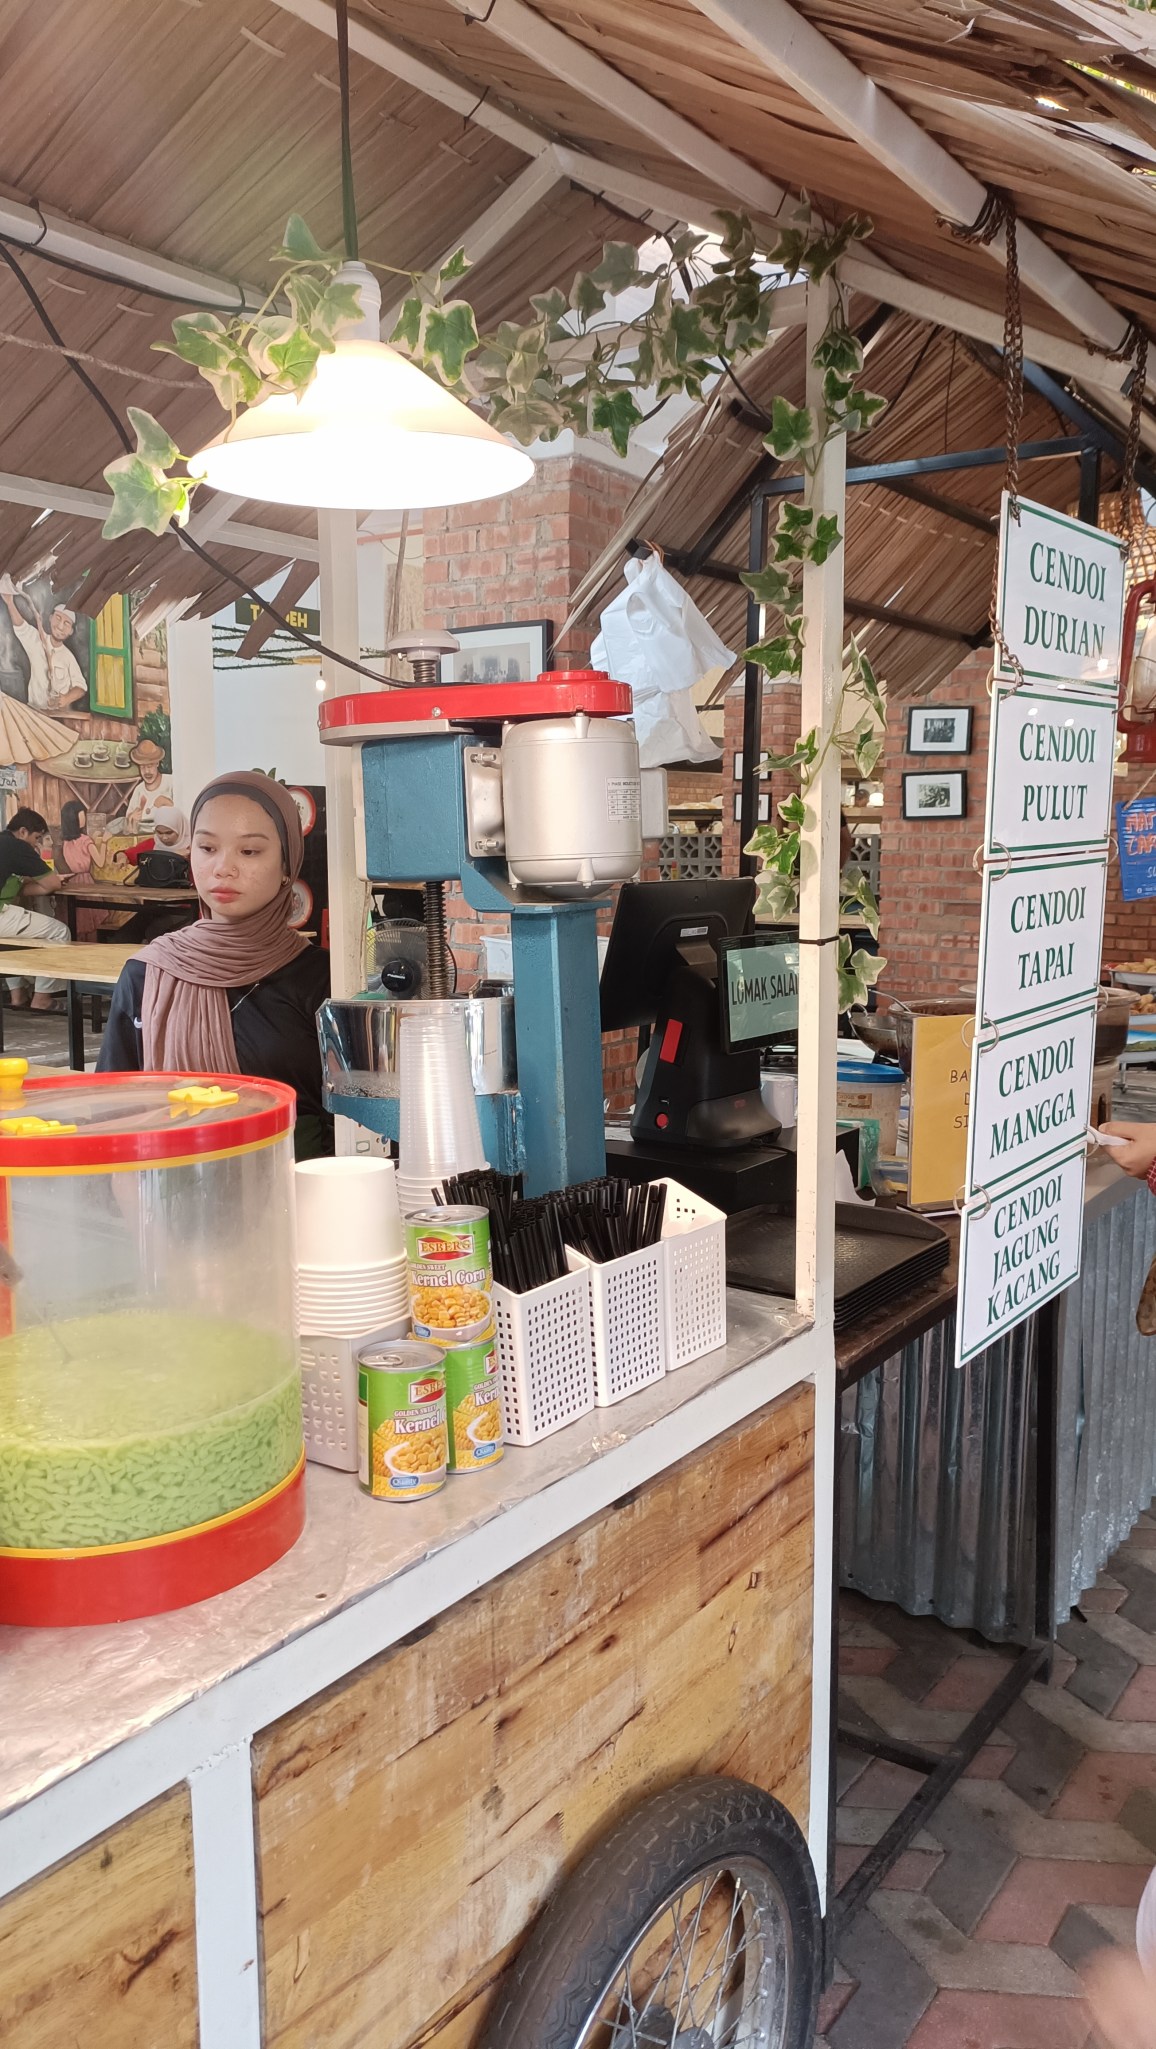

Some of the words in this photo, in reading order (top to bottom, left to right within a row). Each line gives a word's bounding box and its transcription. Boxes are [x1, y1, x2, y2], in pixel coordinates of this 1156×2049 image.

[1030, 542, 1107, 602] CENDOI
[1023, 604, 1106, 659] DURIAN
[1018, 722, 1096, 763] CENDOI
[1021, 783, 1089, 822] PULUT
[1010, 886, 1086, 934] CENDOI
[1018, 942, 1075, 990] TAPAI
[731, 976, 768, 1006] LOMAK
[998, 1036, 1076, 1099] CENDOI
[989, 1092, 1077, 1160] MANGGA
[994, 1173, 1063, 1240] CENDOI
[992, 1213, 1060, 1291] JAGUNG
[411, 1270, 452, 1287] Kernel
[456, 1269, 486, 1284] Corn
[986, 1249, 1061, 1328] KACANG
[394, 1408, 419, 1417] GOLDEN
[394, 1410, 441, 1434] Kernel
